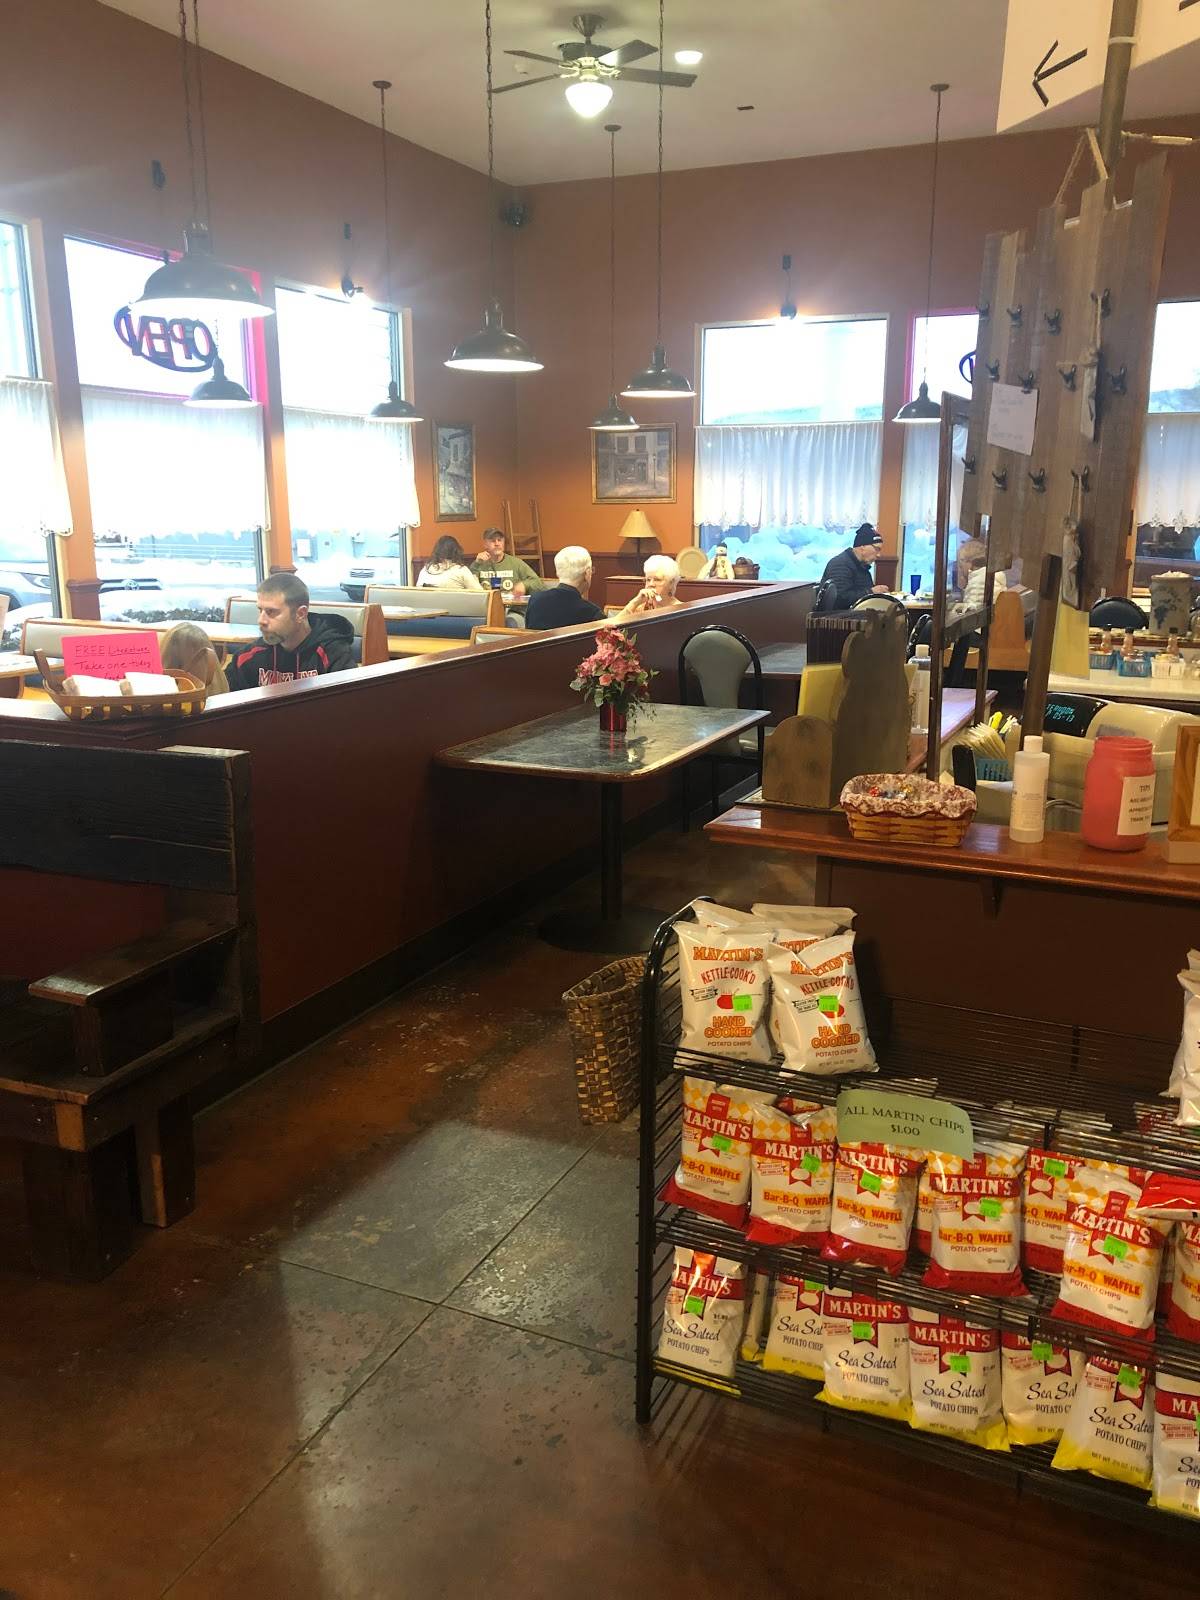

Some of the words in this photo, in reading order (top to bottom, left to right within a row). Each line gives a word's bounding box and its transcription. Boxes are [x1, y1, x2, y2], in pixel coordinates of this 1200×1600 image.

[75, 645, 105, 656] FREE
[73, 661, 105, 671] Take
[693, 946, 764, 961] MARTIN'S
[791, 952, 854, 977] MARTIN'S
[701, 966, 756, 984] KETTLE-COOK'D
[712, 1015, 745, 1027] HAND
[704, 1026, 753, 1038] COOKED
[818, 1024, 851, 1036] HAND
[811, 1034, 860, 1049] COOKED
[840, 1048, 858, 1056] CHIPS
[684, 1107, 751, 1140] MARTIN'S
[844, 1106, 868, 1116] ALL
[872, 1107, 925, 1124] MARTIN
[930, 1117, 965, 1134] CHIPS
[890, 1124, 920, 1136] $1.00
[765, 1141, 834, 1161] MARTIN'S
[840, 1149, 909, 1175] MARTIN'S
[710, 1165, 741, 1181] WAFFLE
[706, 1177, 725, 1186] CHIPS
[935, 1176, 1013, 1196] MARTIN'S
[763, 1191, 799, 1207] Bar-B-Q
[804, 1197, 831, 1207] WAFFL
[837, 1199, 866, 1215] Bar-B-Q
[777, 1206, 802, 1214] POTATO
[849, 1214, 868, 1227] POTATO
[869, 1221, 889, 1230] CHIPS
[1041, 1221, 1062, 1231] CHIPS
[1070, 1204, 1151, 1244] MARTIN'S
[938, 1229, 974, 1243] Bar-B-Q
[979, 1232, 1012, 1243] WAFFLE
[951, 1245, 976, 1253] POTATO
[1064, 1264, 1097, 1281] ar-B-Q
[1103, 1274, 1141, 1296] WAFFLE
[1070, 1278, 1098, 1293] POTATO
[1099, 1289, 1121, 1301] CHIPS
[830, 1300, 901, 1319] MARTIN'S
[664, 1319, 683, 1334] Sea
[684, 1323, 721, 1341] Salted
[777, 1316, 799, 1331] Sea
[801, 1319, 823, 1335] Sal
[783, 1335, 807, 1348] POTATO
[808, 1341, 823, 1351] CHIP
[915, 1326, 991, 1347] MARTIN'S
[667, 1337, 690, 1350] POTATO
[690, 1345, 711, 1356] CHIPS
[835, 1350, 859, 1367] Sea
[861, 1352, 897, 1369] Salted
[842, 1372, 868, 1384] POTATO
[869, 1375, 889, 1386] CHIPS
[923, 1379, 945, 1397] Sea
[948, 1380, 987, 1399] Salted
[1027, 1382, 1052, 1400] Sea
[1055, 1381, 1078, 1400] Sal
[930, 1400, 956, 1413] POTATO
[957, 1404, 979, 1415] CHIPS
[1035, 1404, 1064, 1414] POTATO
[1089, 1406, 1116, 1427] Sea
[1095, 1427, 1124, 1445] POTATO
[1125, 1438, 1147, 1451] CHIPS
[1186, 1478, 1200, 1489] POT
